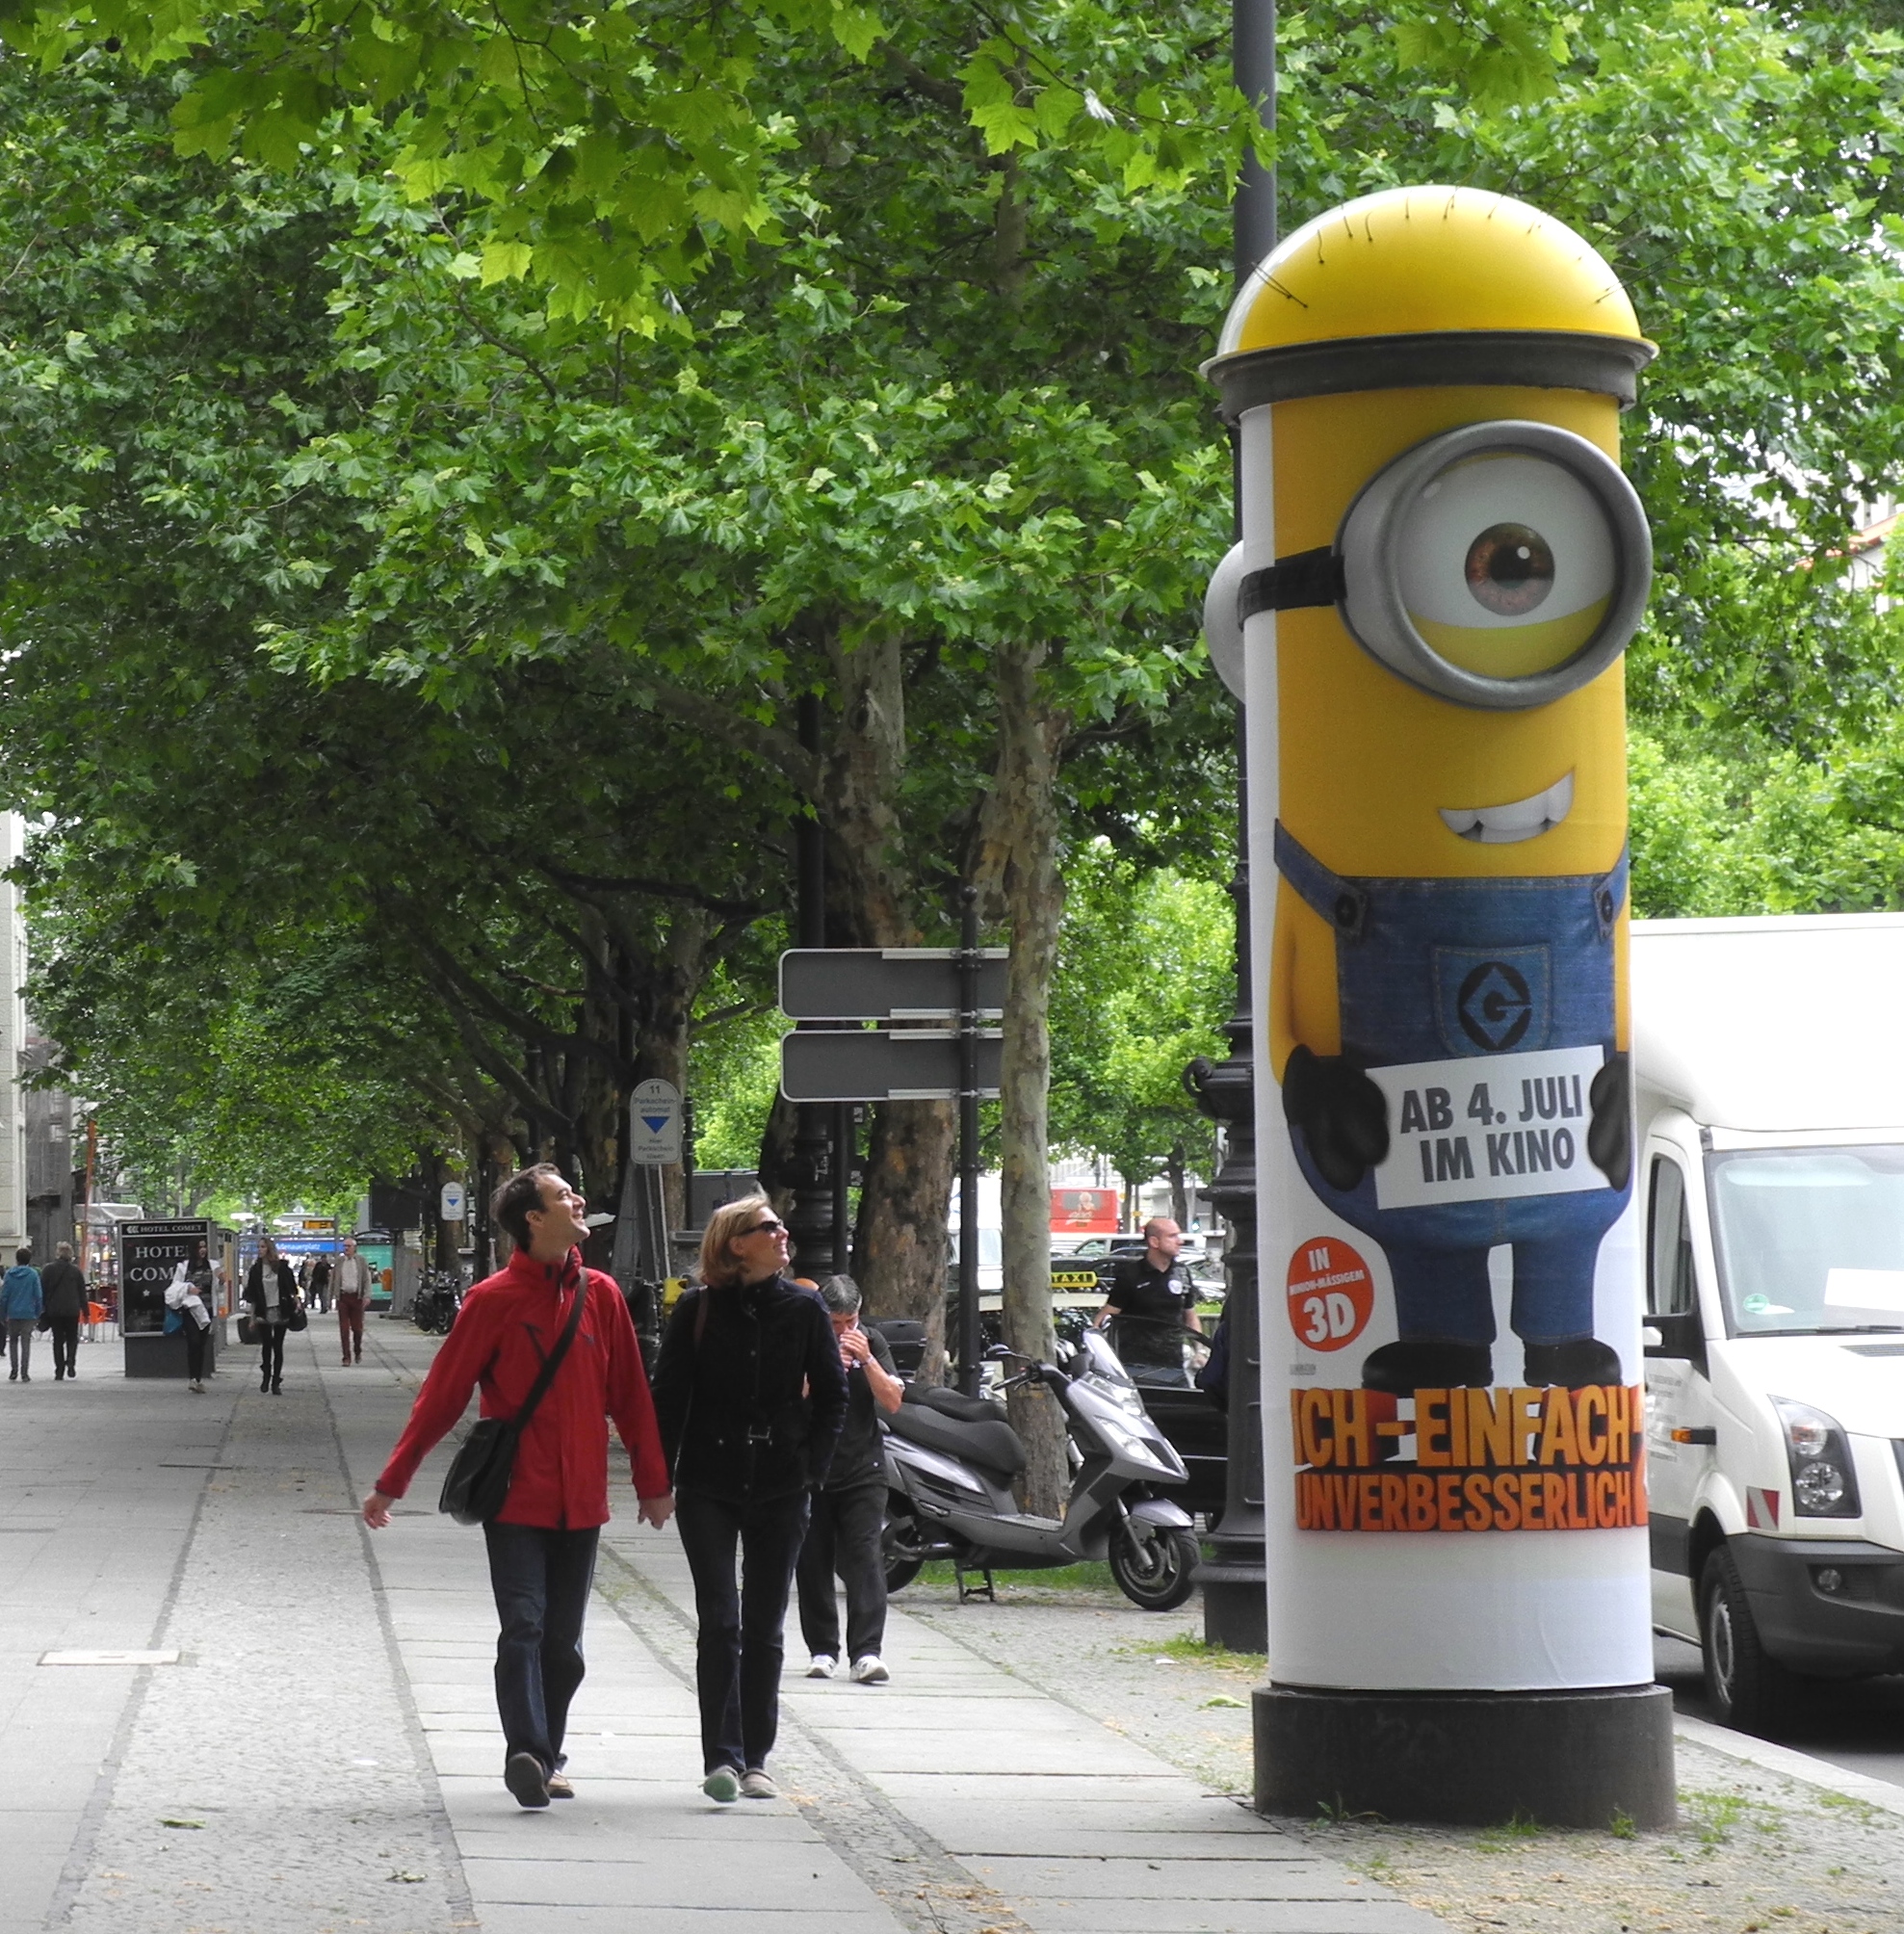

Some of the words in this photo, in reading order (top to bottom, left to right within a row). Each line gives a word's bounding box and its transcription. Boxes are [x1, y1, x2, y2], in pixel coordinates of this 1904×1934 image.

[649, 1085, 661, 1094] 11
[1400, 1086, 1454, 1135] AB
[1467, 1083, 1507, 1126] 4.
[1519, 1074, 1583, 1122] JULI
[1421, 1137, 1474, 1183] IM
[1486, 1127, 1575, 1177] KINO
[1052, 1272, 1088, 1283] TAXI
[1308, 1246, 1331, 1272] IN
[1303, 1293, 1356, 1344] 3D
[1294, 1471, 1630, 1531] UNVERBESSERLICH
